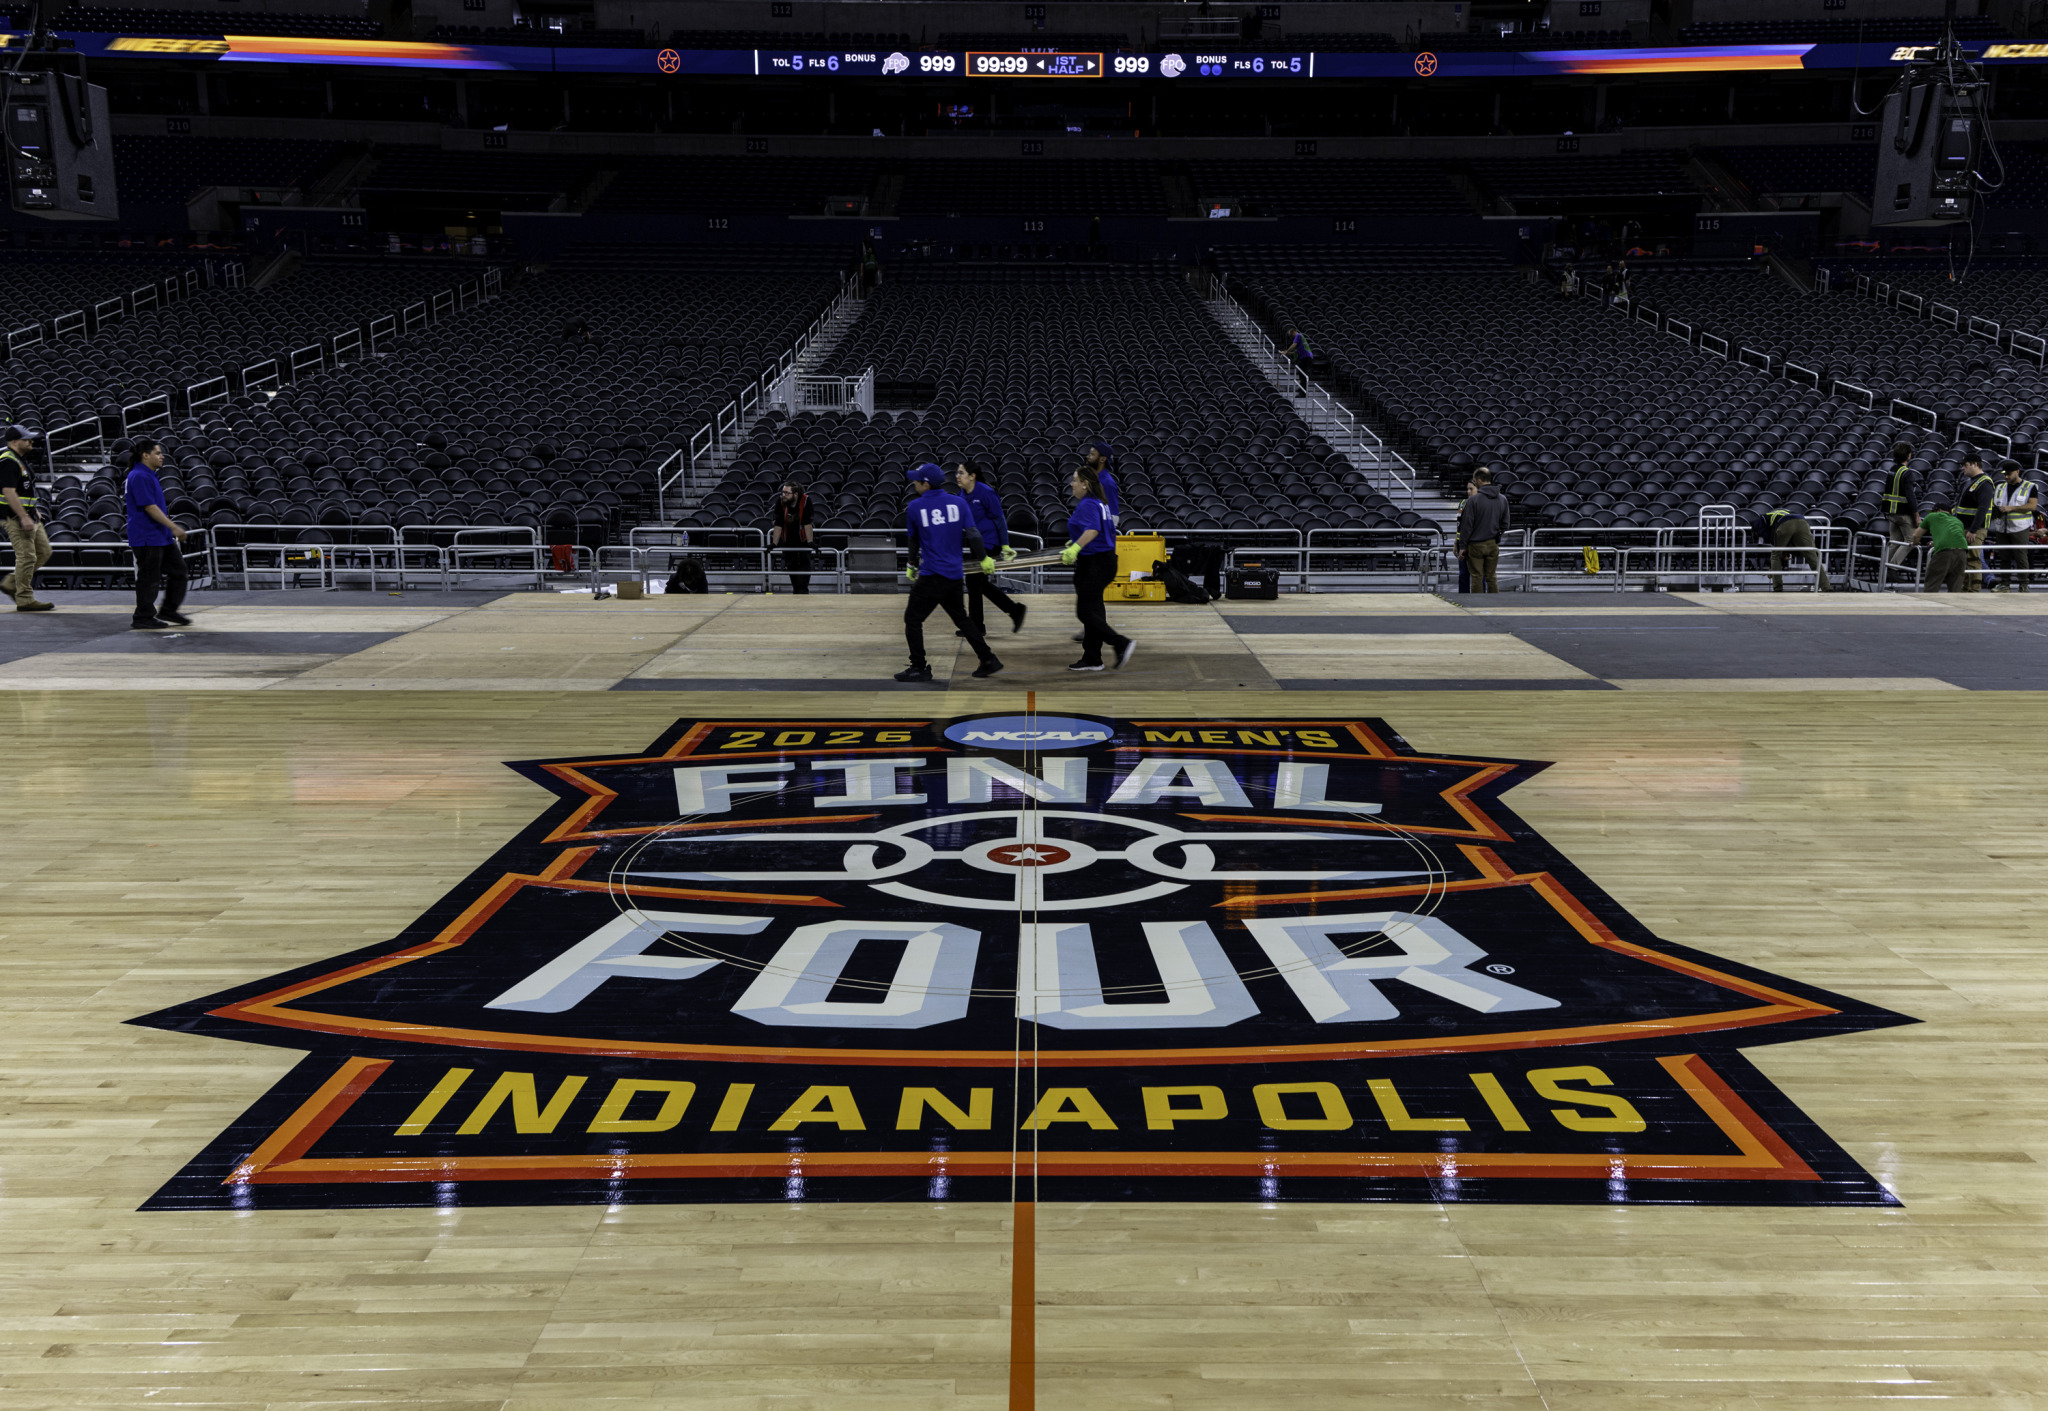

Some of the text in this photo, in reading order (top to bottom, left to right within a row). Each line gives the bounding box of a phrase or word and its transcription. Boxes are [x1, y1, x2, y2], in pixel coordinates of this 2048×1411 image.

[772, 5, 791, 14] 312
[1027, 7, 1044, 16] 313
[1262, 8, 1279, 17] 314
[1581, 4, 1600, 13] 315
[773, 55, 803, 70] TOL 5
[845, 54, 876, 62] BONUS
[888, 58, 907, 68] FPO
[809, 56, 839, 71] FLS 6
[920, 56, 955, 71] 999
[977, 57, 1028, 73] 99:99
[1114, 57, 1149, 73] 999
[1162, 59, 1184, 70] FPO
[1235, 57, 1264, 73] FLS 6
[1271, 58, 1301, 72] TOL 5
[1048, 65, 1084, 74] HALF
[168, 120, 189, 131] 210
[1854, 128, 1873, 137] 216
[486, 136, 505, 145] 211
[748, 141, 767, 150] 212
[1559, 140, 1578, 150] 215
[1024, 143, 1042, 152] 213
[1297, 143, 1315, 152] 214
[342, 215, 363, 225] 111
[709, 218, 728, 229] 112
[1699, 220, 1720, 230] 115
[1024, 221, 1044, 231] 113
[1335, 221, 1355, 231] 114
[720, 731, 1338, 749] 2026 NCAA MEN'S
[673, 757, 1383, 815] FINAL
[484, 908, 1562, 1030] FOUR
[394, 1065, 1647, 1136] INDIANAPOLIS
